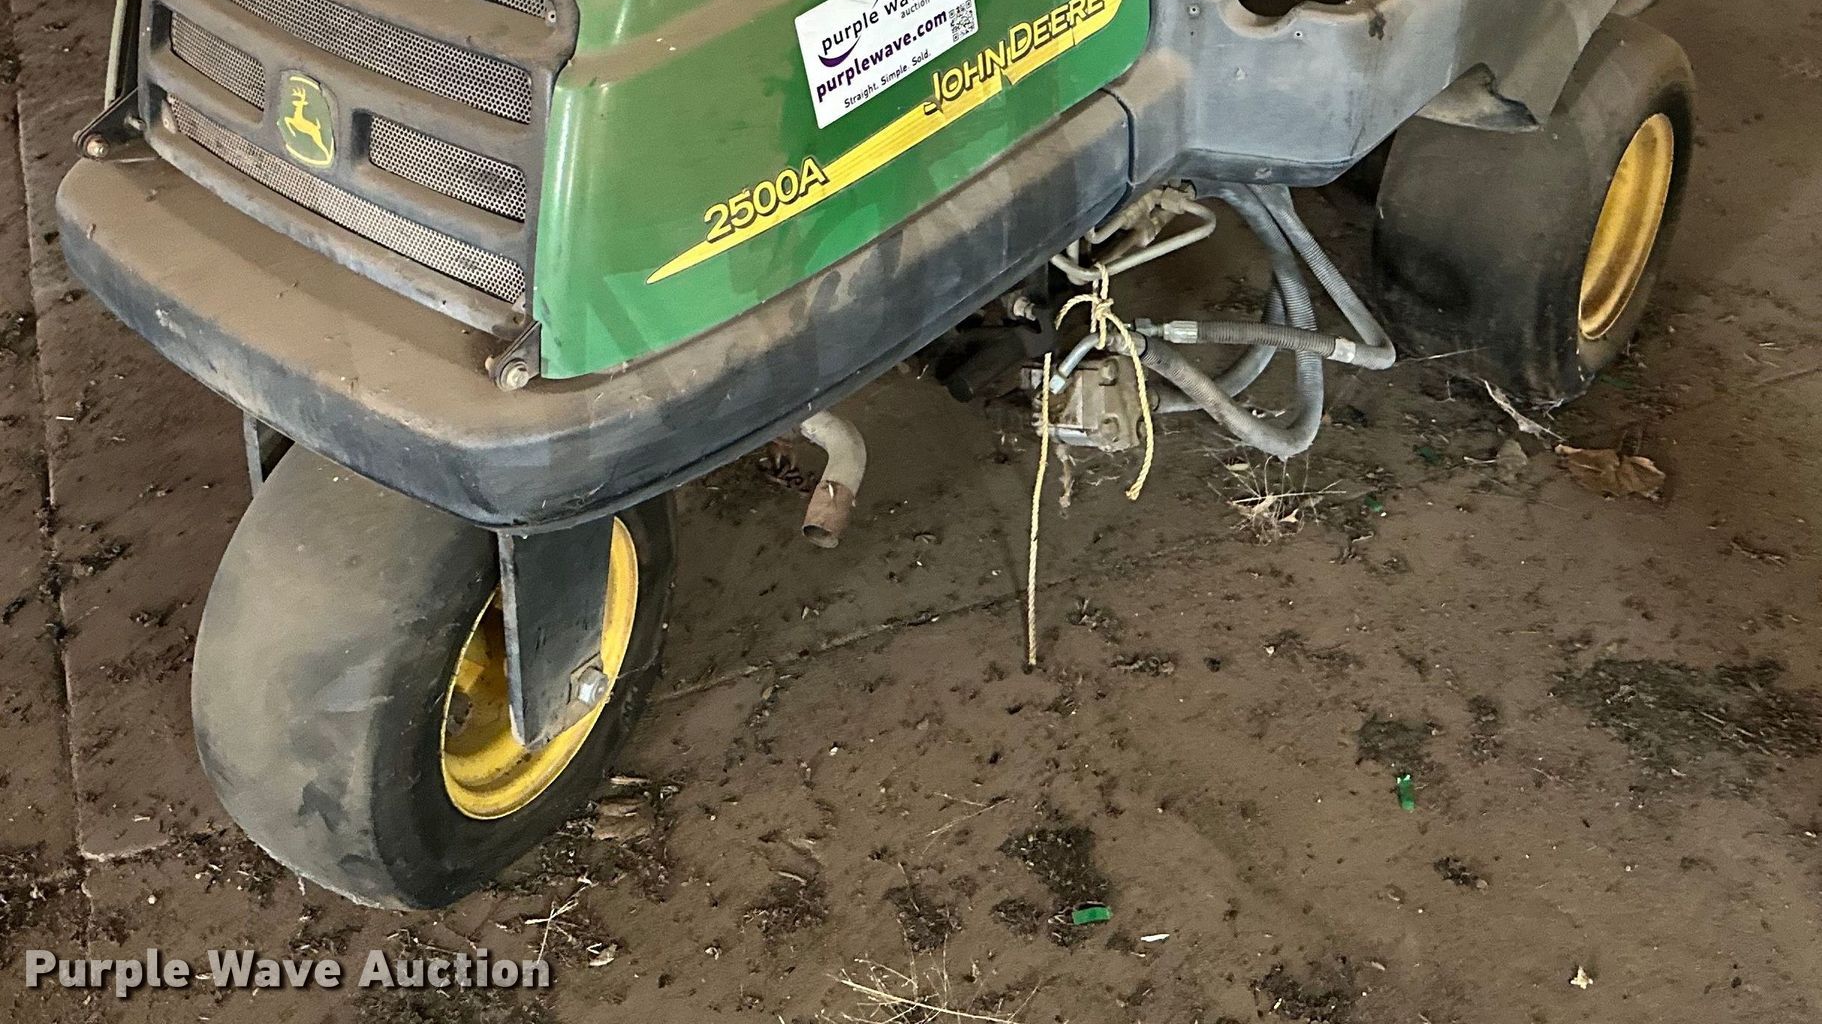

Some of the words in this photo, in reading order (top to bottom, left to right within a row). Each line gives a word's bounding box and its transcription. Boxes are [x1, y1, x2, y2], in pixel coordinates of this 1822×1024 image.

[816, 9, 948, 103] purplewave.com
[821, 9, 880, 55] purple
[844, 82, 879, 108] Straight.
[881, 63, 910, 86] Simple.
[912, 48, 931, 67] Sold.
[923, 41, 1007, 114] JOHN
[703, 156, 830, 243] 2500A
